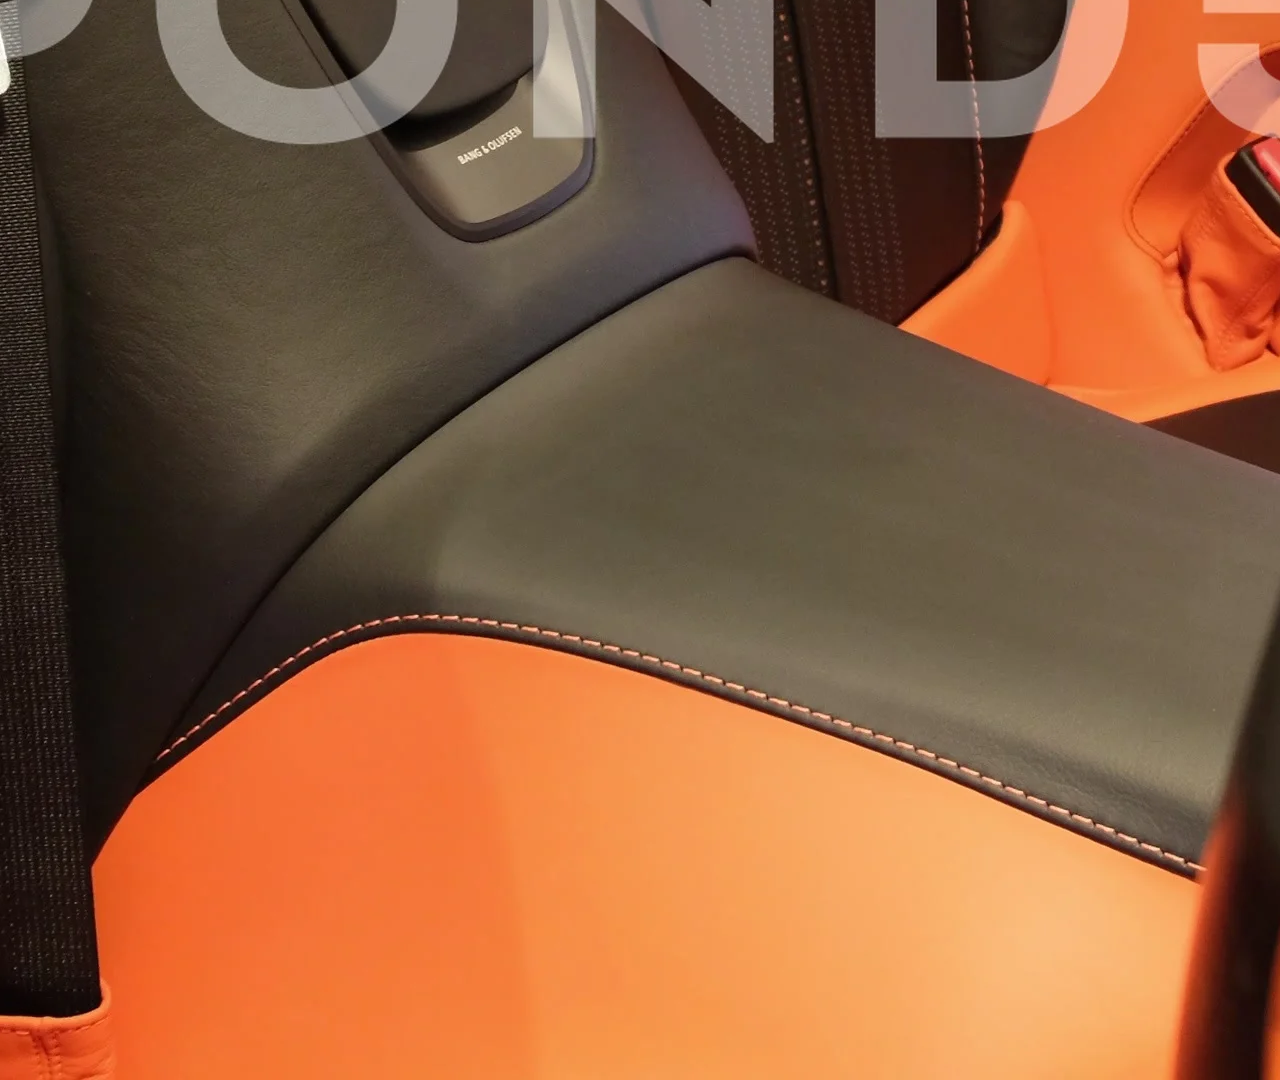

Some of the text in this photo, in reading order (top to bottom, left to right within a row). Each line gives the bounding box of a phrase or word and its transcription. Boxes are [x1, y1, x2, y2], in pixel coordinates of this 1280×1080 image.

[457, 126, 522, 165] BANG & OLUFSEN
